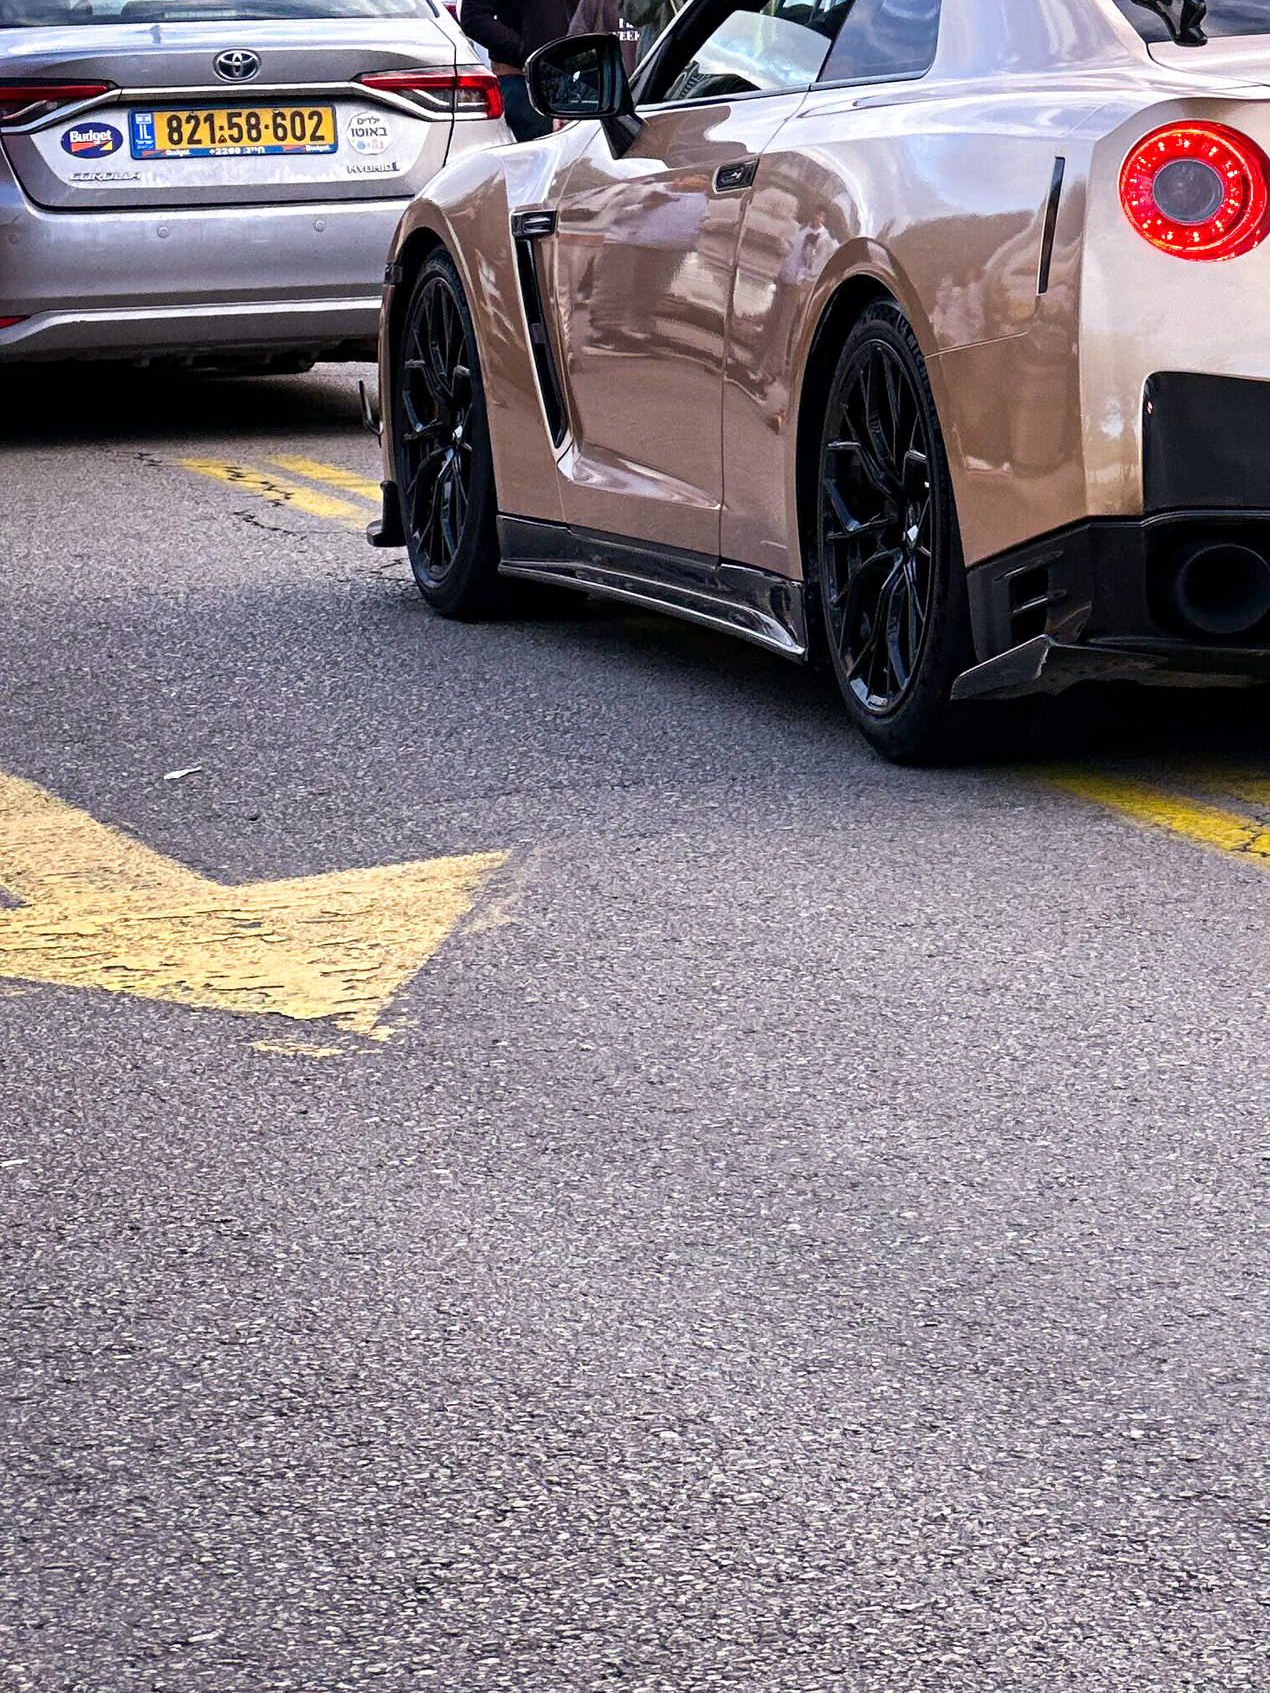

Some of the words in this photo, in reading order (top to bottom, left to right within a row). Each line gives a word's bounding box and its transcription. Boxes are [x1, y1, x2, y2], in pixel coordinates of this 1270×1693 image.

[356, 115, 380, 125] ילדים
[69, 129, 113, 144] Budget
[139, 124, 152, 140] IL
[351, 126, 388, 137] באוטו
[69, 172, 142, 182] COROLLA
